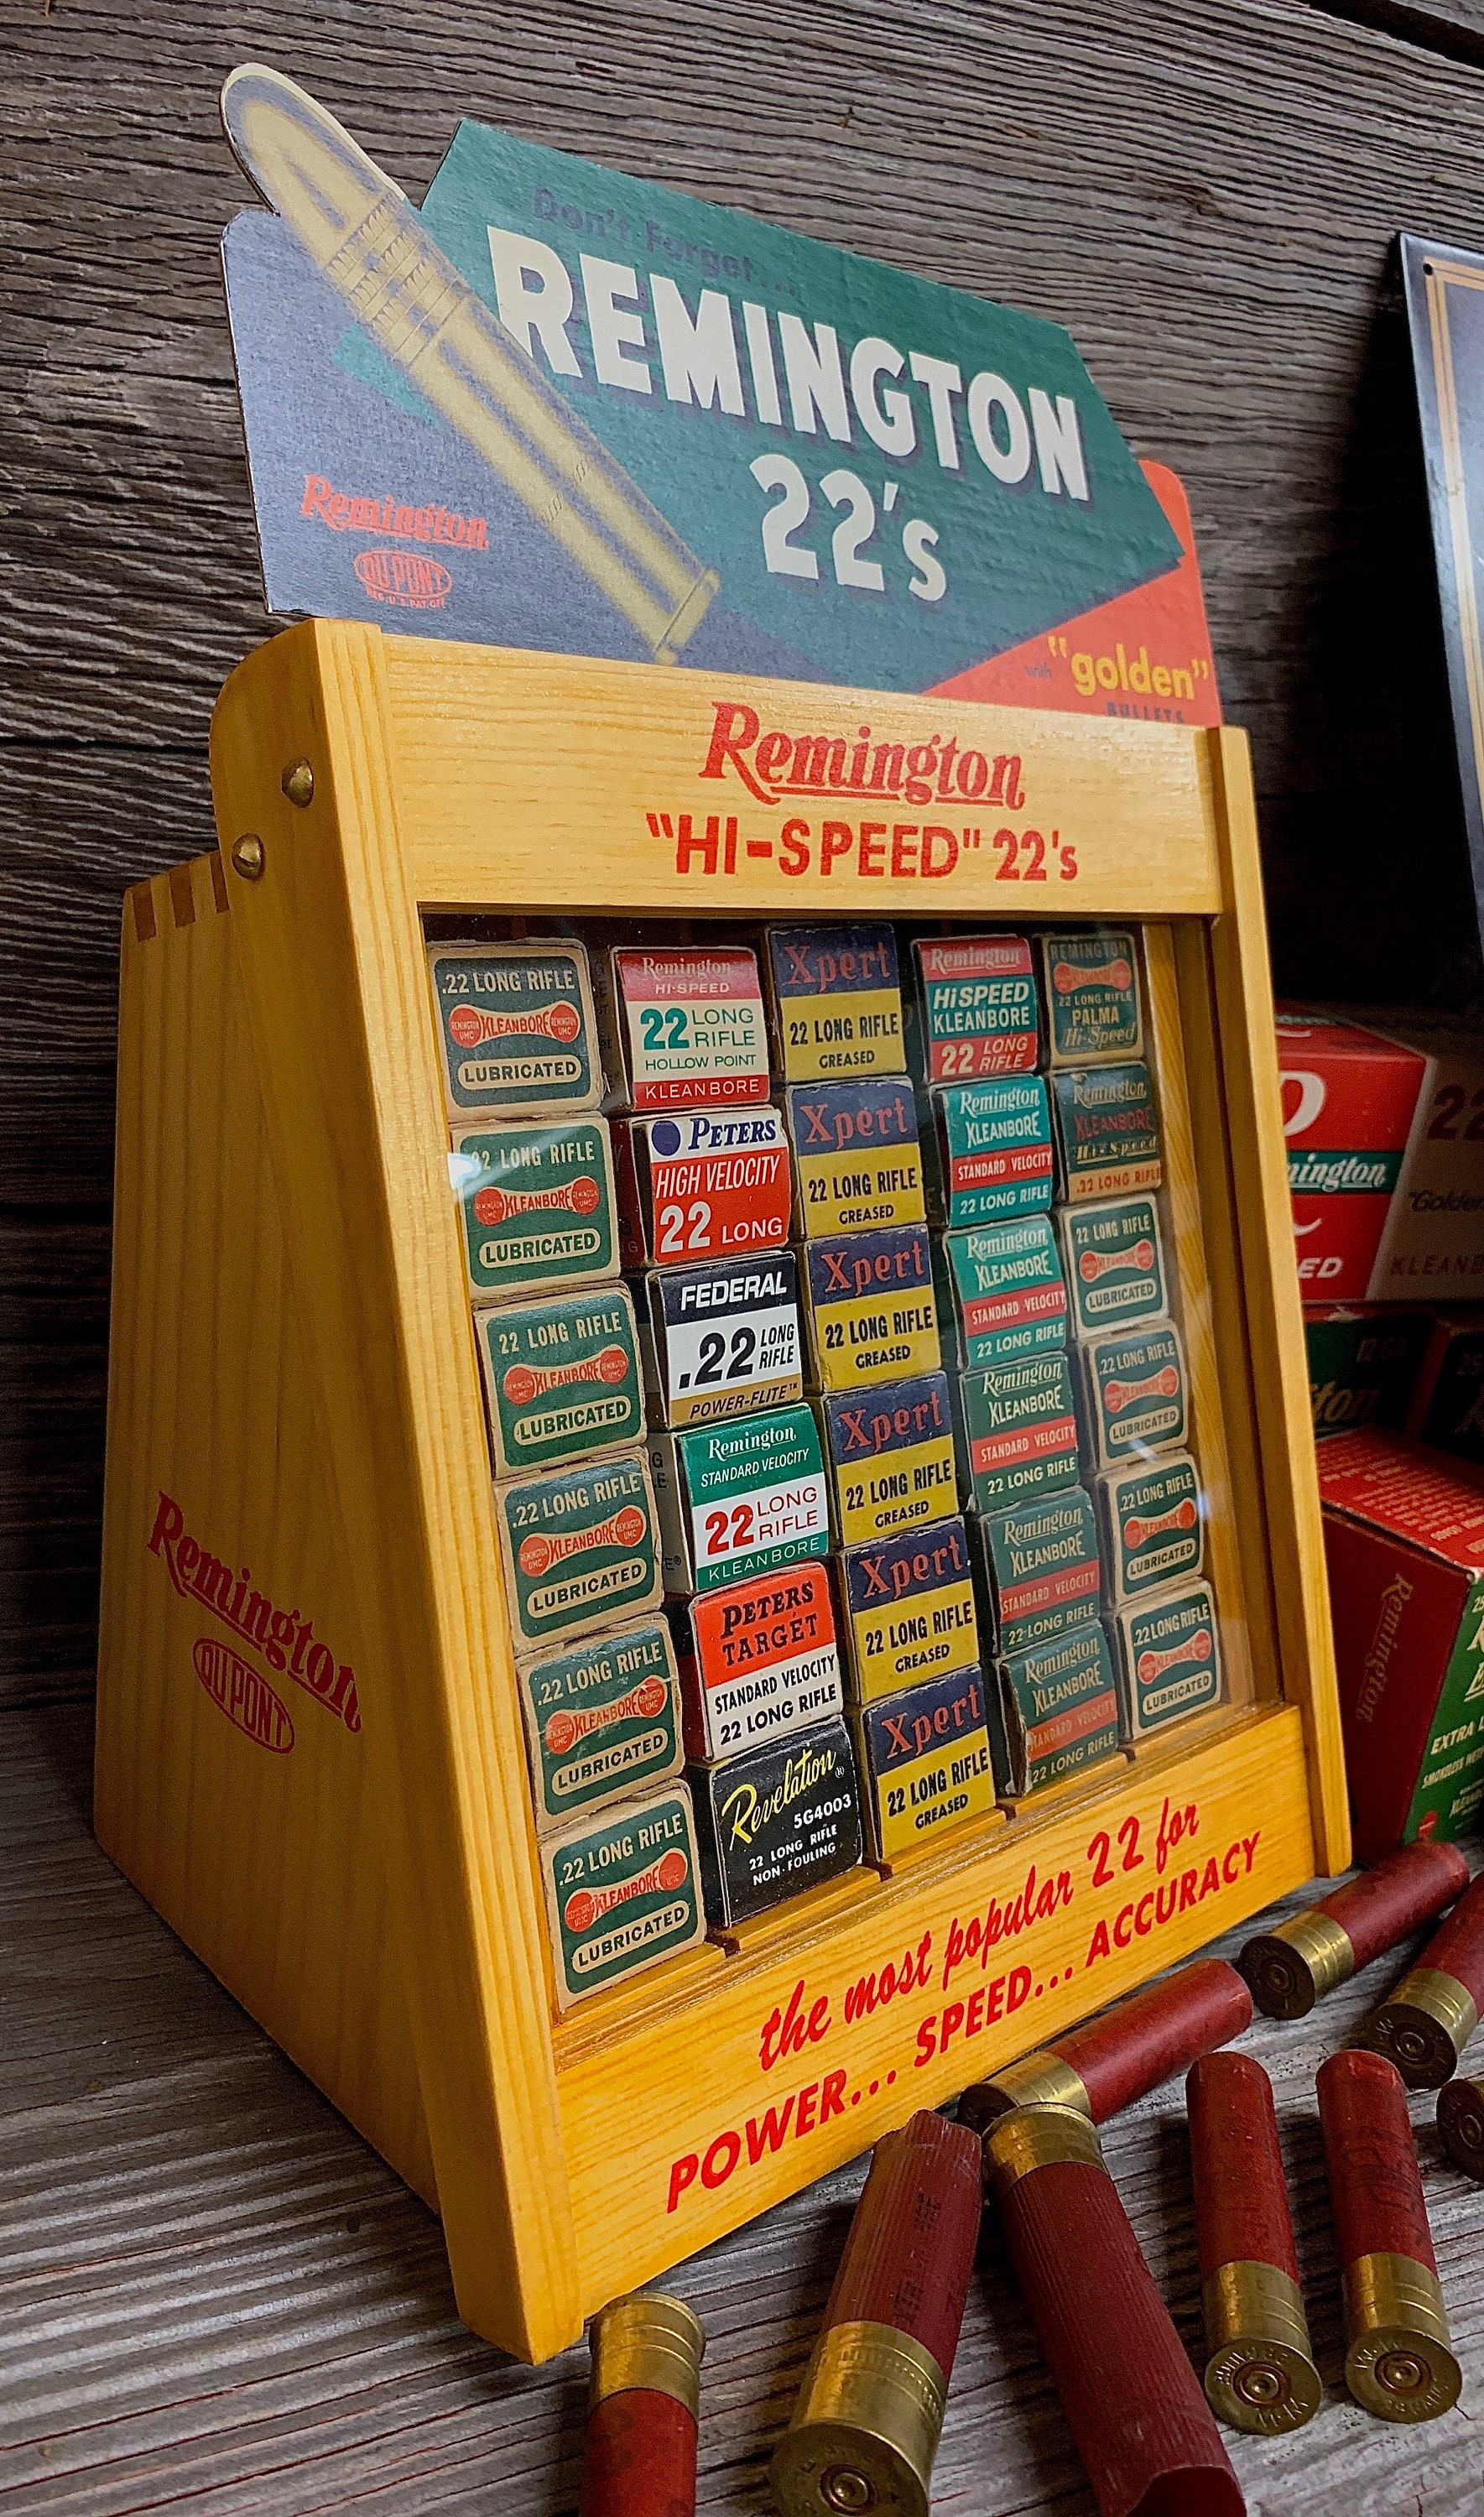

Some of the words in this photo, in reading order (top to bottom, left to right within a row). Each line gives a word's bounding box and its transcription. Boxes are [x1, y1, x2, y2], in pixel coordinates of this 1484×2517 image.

[534, 185, 630, 241] Don't
[487, 225, 1091, 502] REMINGTON
[299, 473, 490, 550] Remington
[748, 453, 948, 602] 22's
[1048, 634, 1210, 701] "golden"
[1106, 701, 1185, 724] BULLETS
[699, 701, 1025, 810] Remington
[646, 813, 980, 879] "HI-SPEED"
[993, 829, 1079, 881] 22's
[642, 957, 732, 980] Remington
[784, 941, 891, 993] Xpert
[930, 947, 1021, 972] Remington
[1050, 941, 1127, 961] REMINGTON
[442, 973, 470, 994] .22
[473, 971, 522, 993] LONG
[527, 969, 575, 990] RIFLE
[1059, 996, 1071, 1007] 22
[1075, 993, 1101, 1006] LONG
[1104, 991, 1133, 1004] RIFLE
[480, 1011, 551, 1039] KLEANBORE
[640, 1008, 690, 1051] 22
[692, 1008, 753, 1025] LONG
[789, 1023, 808, 1045] 22
[814, 1018, 853, 1044] LONG
[859, 1012, 899, 1038] RIFLE
[933, 1007, 1030, 1034] KLEANBORE
[1072, 1006, 1120, 1026] PALMA
[695, 1030, 756, 1048] RIFLE
[940, 1044, 973, 1076] 22
[982, 1037, 1028, 1055] LONG
[464, 1061, 577, 1084] LUBRICATED
[645, 1056, 709, 1071] HOLLOW
[715, 1054, 757, 1067] POINT
[819, 1050, 875, 1069] GREASED
[979, 1054, 1023, 1072] RIFLE
[645, 1079, 760, 1100] KLEANBORE
[959, 1087, 1039, 1118] Remington
[1073, 1079, 1148, 1108] Remington
[688, 1118, 776, 1151] PETERS
[799, 1097, 909, 1149] Xpert
[966, 1113, 1042, 1149] KLEANBORE
[1075, 1105, 1155, 1141] KLEANBORE
[655, 1167, 700, 1199] HIGH
[706, 1154, 779, 1193] VELOCITY
[808, 1179, 827, 1203] 22
[833, 1171, 871, 1200] LONG
[876, 1165, 918, 1192] RIFLE
[957, 1160, 1006, 1181] STANDARD
[1012, 1151, 1052, 1173] VELOCITY
[502, 1187, 574, 1217] KLEANBORE
[838, 1203, 895, 1225] GREASED
[959, 1198, 976, 1216] 22
[980, 1191, 1016, 1212] LONG
[1019, 1185, 1049, 1204] RIFLE
[659, 1201, 711, 1254] 22
[721, 1217, 784, 1244] LONG
[966, 1228, 1049, 1262] Remington
[1093, 1221, 1119, 1241] LONG
[1122, 1213, 1151, 1235] RIFLE
[485, 1232, 596, 1263] LUBRICATED
[820, 1240, 924, 1297] Xpert
[974, 1252, 1053, 1291] KLEANBORE
[680, 1271, 788, 1312] FEDERAL
[971, 1302, 1019, 1326] STANDARD
[1024, 1290, 1066, 1313] VELOCITY
[1088, 1283, 1153, 1309] LUBRICATED
[528, 1321, 570, 1349] LONG
[576, 1311, 622, 1338] RIFLE
[825, 1325, 845, 1350] 22
[850, 1315, 888, 1345] LONG
[893, 1305, 934, 1337] RIFLE
[976, 1340, 993, 1357] 22
[996, 1331, 1032, 1353] LONG
[1034, 1324, 1065, 1344] RIFLE
[678, 1327, 756, 1389] .22
[760, 1323, 794, 1349] LONG
[758, 1345, 795, 1370] RIFLE
[855, 1344, 911, 1369] GREASED
[533, 1359, 602, 1395] KLEANBORE
[982, 1362, 1064, 1396] Remington
[518, 1399, 628, 1441] LUBRICATED
[839, 1390, 943, 1457] Xpert
[988, 1384, 1065, 1428] KLEANBORE
[708, 1425, 797, 1461] Remington
[700, 1461, 760, 1488] STANDARD
[762, 1448, 810, 1473] VELOCITY
[513, 1502, 540, 1528] .22
[543, 1488, 589, 1519] LONG
[594, 1473, 641, 1503] RIFLE
[548, 1519, 618, 1564] KLEANBORE
[705, 1503, 755, 1557] 22
[758, 1487, 818, 1517] LONG
[758, 1509, 819, 1542] RIFLE
[1003, 1505, 1084, 1546] Remington
[708, 1536, 820, 1582] KLEANBORE
[859, 1535, 963, 1601] Xpert
[1009, 1530, 1086, 1577] KLEANBORE
[533, 1564, 643, 1612] LUBRICATED
[146, 1490, 362, 1733] Remington
[720, 1581, 814, 1639] PETERS
[722, 1613, 819, 1668] TARGET
[1356, 1571, 1414, 1722] Remington
[715, 1675, 778, 1717] STANDARD
[781, 1654, 836, 1691] VELOCITY
[1146, 1675, 1210, 1711] LUBRICATED
[720, 1721, 743, 1746] 22
[746, 1703, 795, 1736] LONG
[799, 1684, 837, 1717] RIFLE
[882, 1684, 982, 1760] Xpert
[1430, 1721, 1476, 1755] EXTRA
[557, 1735, 664, 1789] LUBRICATED
[721, 1743, 836, 1851] Revelation
[794, 1794, 851, 1829] 5G4003
[914, 1794, 968, 1831] GREASED
[560, 1860, 586, 1887] .22
[588, 1839, 633, 1872] LONG
[638, 1813, 684, 1851] RIFLE
[749, 1855, 764, 1871] 22
[770, 1840, 803, 1862] LONG
[810, 1824, 837, 1846] RIFLE
[1085, 1833, 1261, 1967] ACCURACY
[577, 1905, 685, 1967] LUBRICATED
[758, 1980, 831, 2072] the
[844, 1936, 934, 2029] most
[942, 1864, 1075, 1992] popular
[1086, 1815, 1145, 1889] 22
[1154, 1796, 1200, 1869] for
